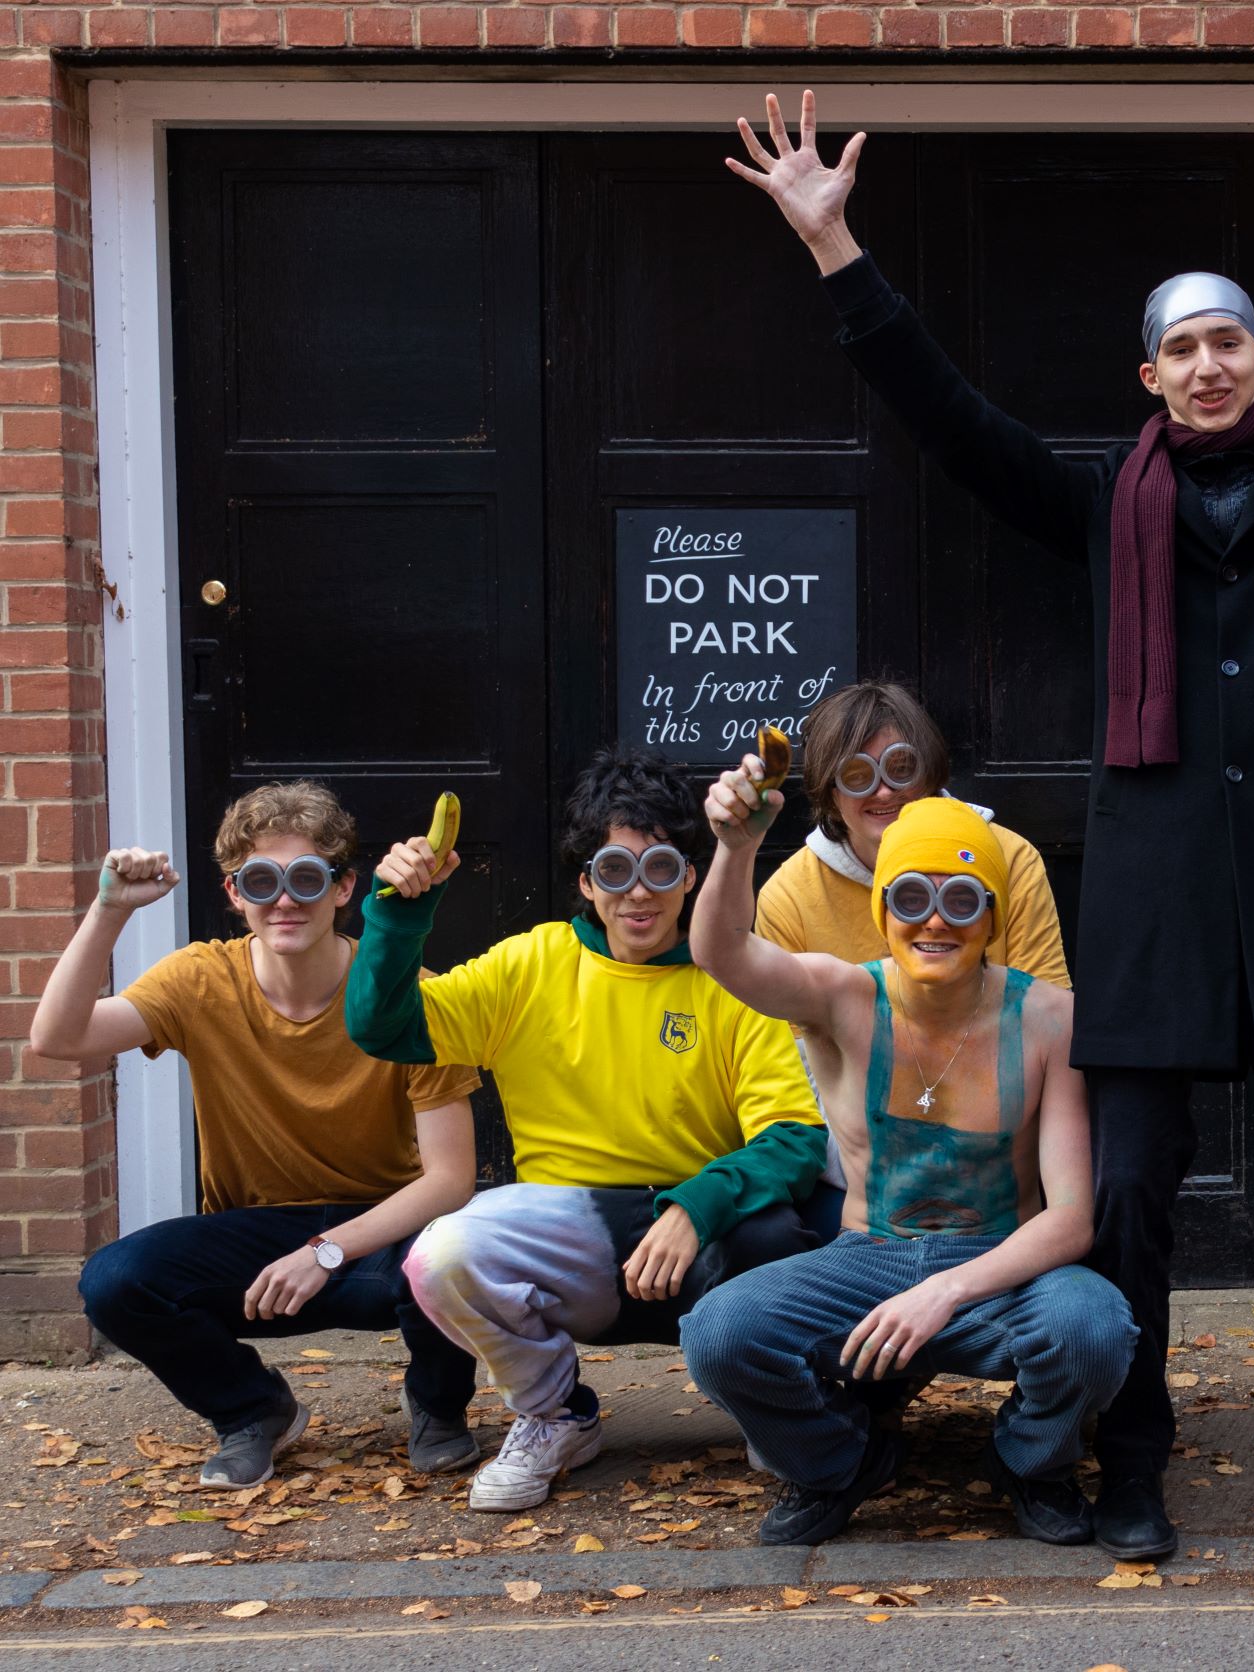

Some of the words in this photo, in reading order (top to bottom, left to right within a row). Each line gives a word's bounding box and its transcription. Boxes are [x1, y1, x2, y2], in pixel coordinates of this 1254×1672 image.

[653, 525, 743, 554] Please
[645, 573, 705, 605] DO
[728, 574, 820, 605] NOT
[669, 621, 798, 654] PARK
[642, 675, 675, 707] In
[680, 671, 784, 714] front
[799, 666, 837, 708] of
[645, 710, 701, 745] this
